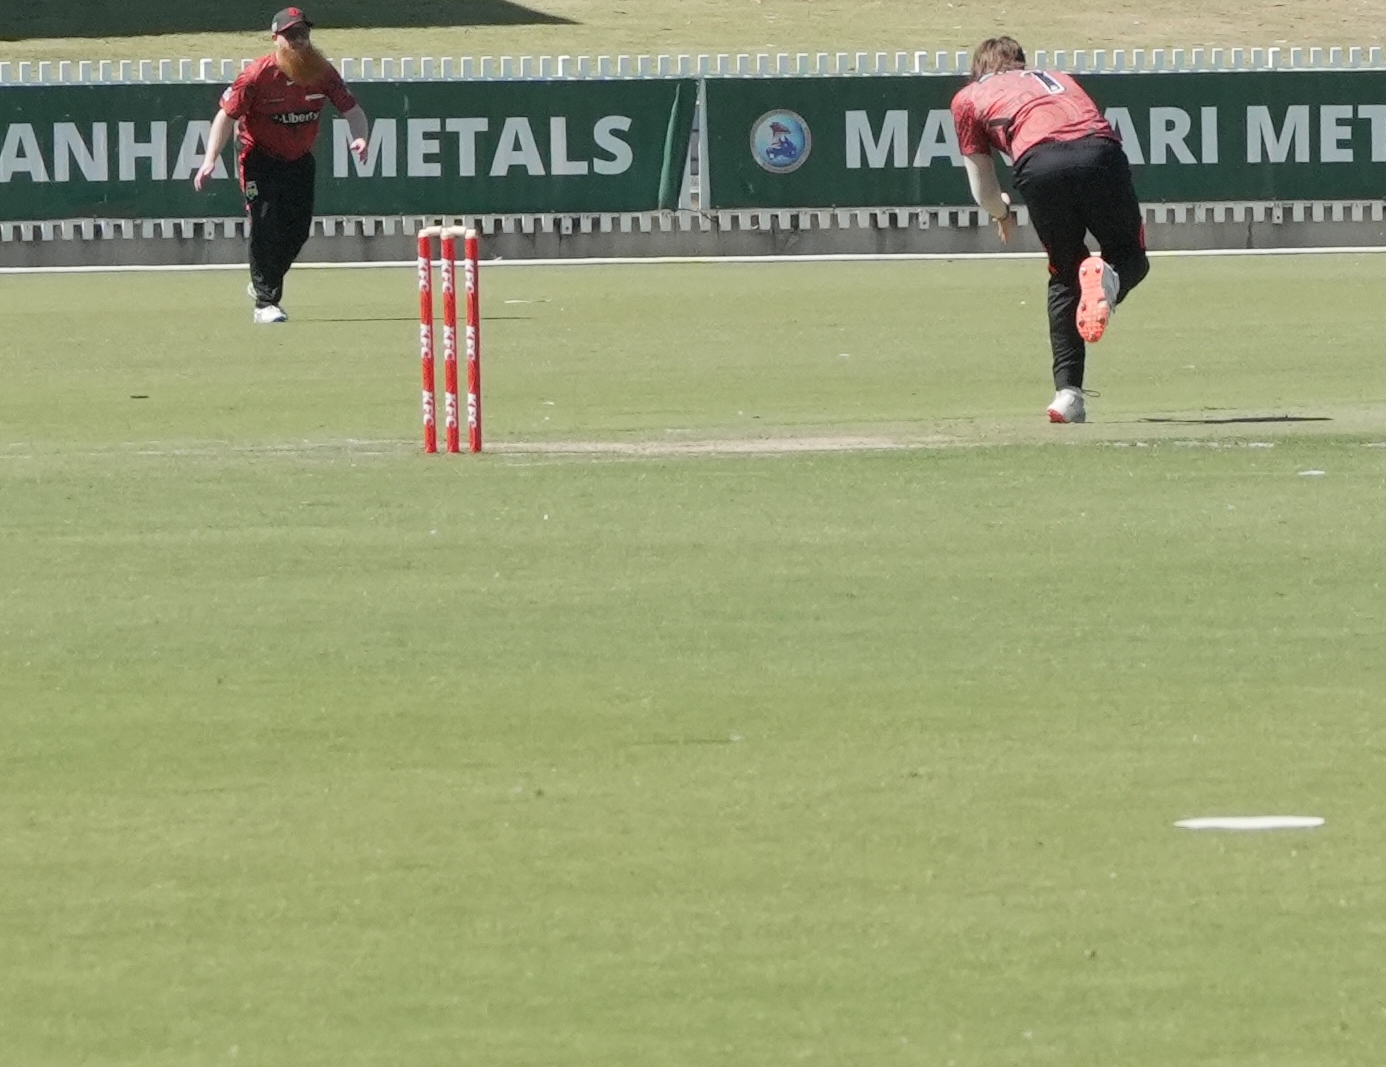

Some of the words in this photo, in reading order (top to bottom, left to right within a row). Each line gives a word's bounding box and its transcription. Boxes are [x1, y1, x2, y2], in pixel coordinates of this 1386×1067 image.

[282, 112, 320, 124] Liberty
[332, 115, 633, 178] METALS
[845, 106, 1219, 169] MAARI
[418, 257, 430, 293] KFC
[441, 259, 453, 293] KFC
[464, 259, 475, 293] KFC
[420, 324, 431, 359] KFC
[443, 325, 455, 360] KFC
[466, 325, 476, 360] KFC
[422, 390, 434, 426] KFC
[445, 392, 457, 428] KFC
[467, 393, 477, 428] KFC
